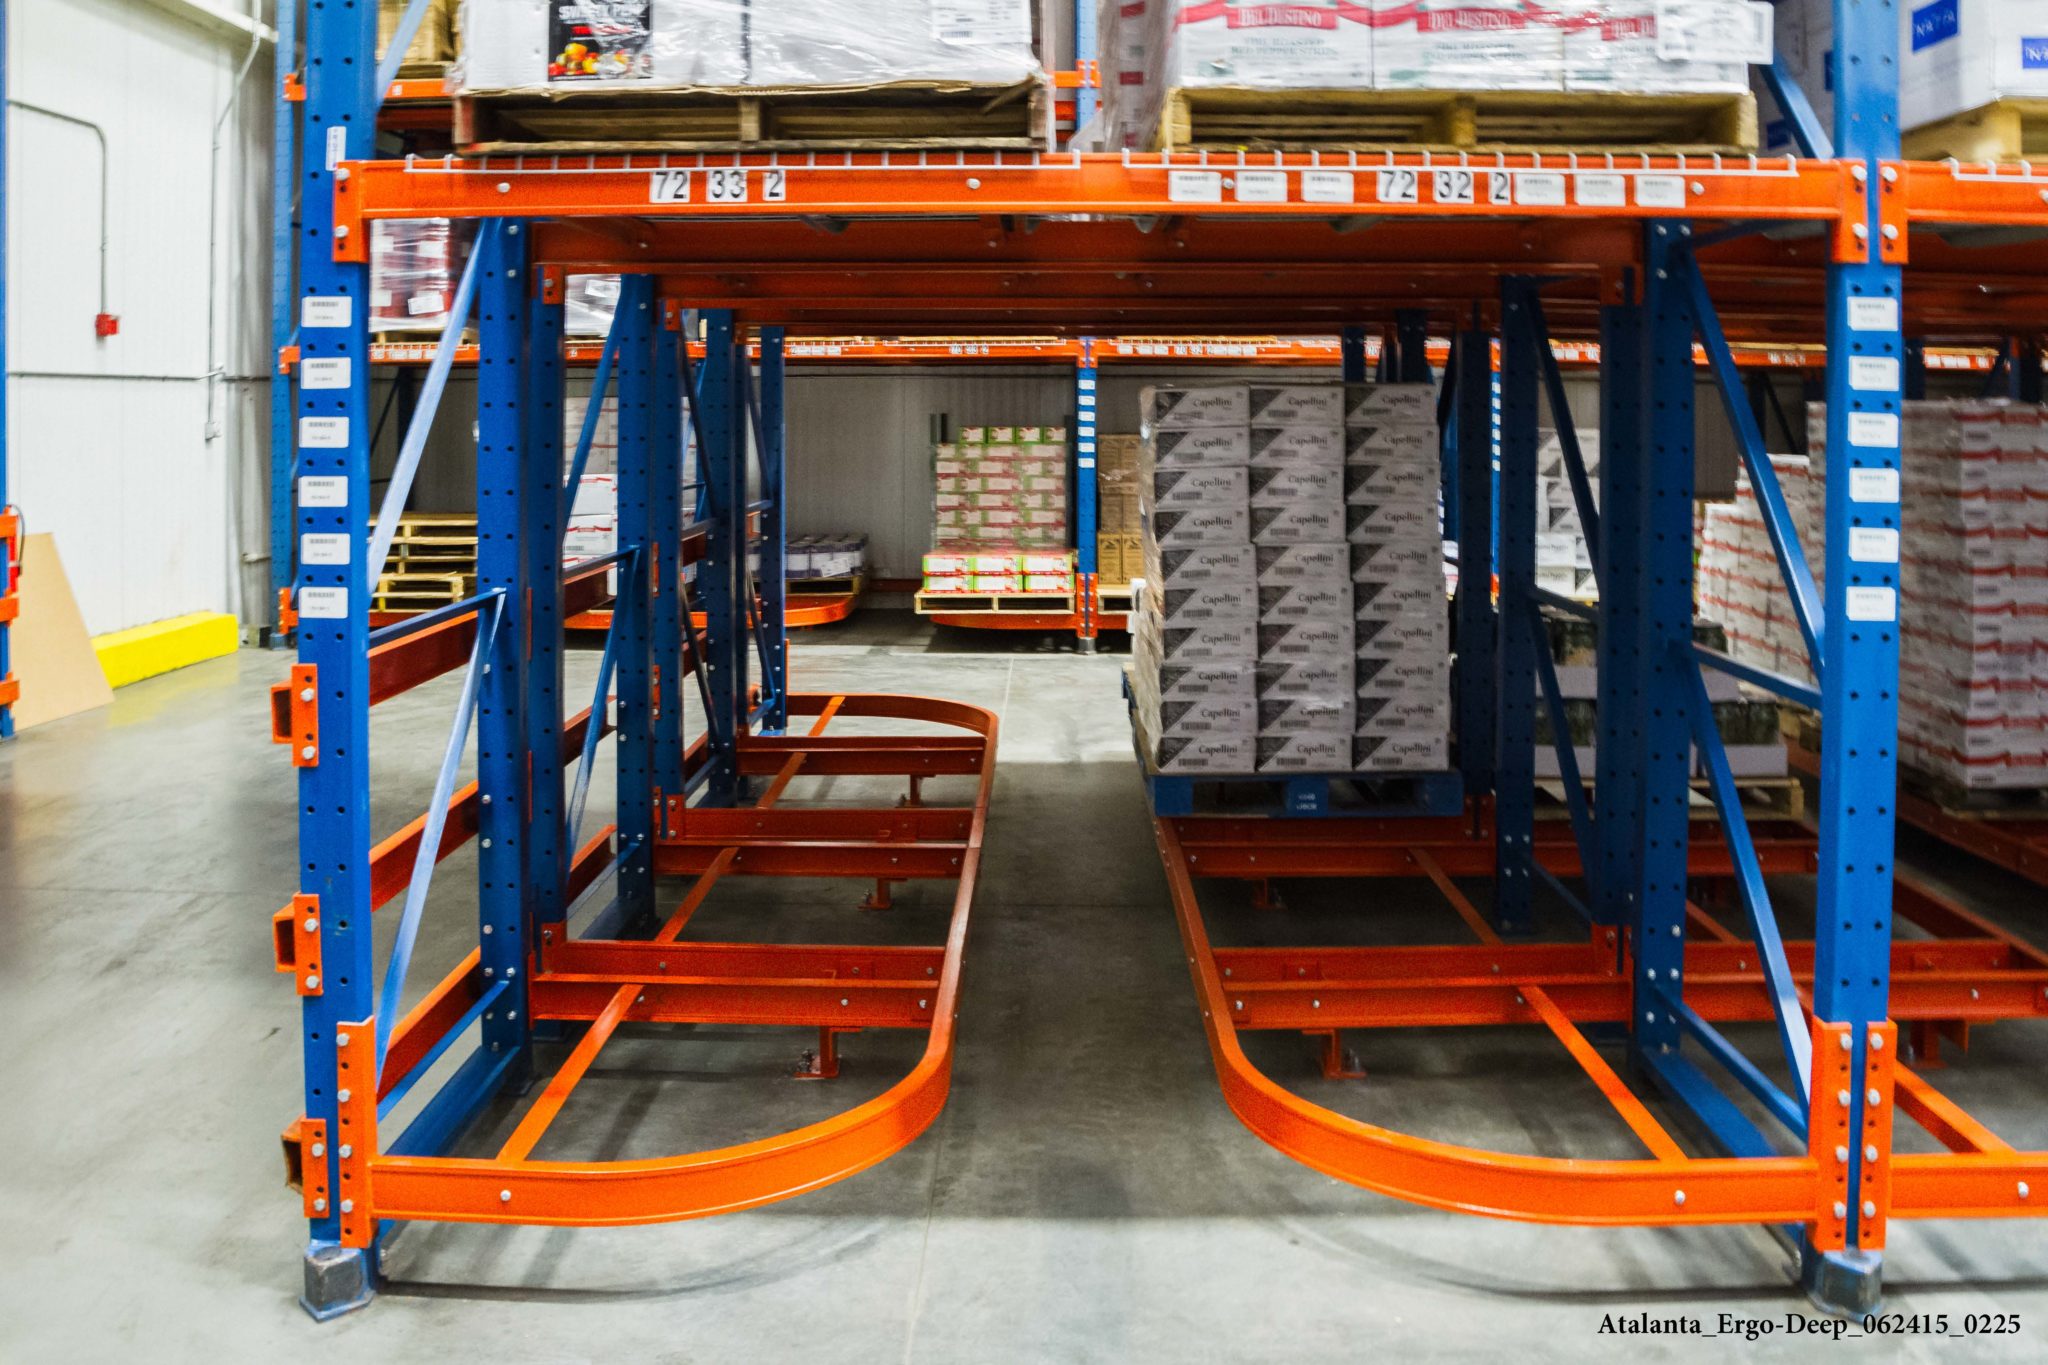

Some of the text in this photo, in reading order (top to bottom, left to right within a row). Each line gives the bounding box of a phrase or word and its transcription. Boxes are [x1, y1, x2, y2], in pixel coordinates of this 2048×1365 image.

[655, 170, 783, 199] 72 33 2
[1382, 170, 1416, 199] 72
[1438, 171, 1472, 200] 32
[1494, 172, 1509, 201] 2
[1193, 396, 1233, 409] Capellini
[1288, 395, 1328, 408] Capellini
[1382, 393, 1422, 406] Capellini
[1194, 436, 1234, 449] Capellini
[1289, 434, 1329, 447] Capellini
[1384, 433, 1424, 446] Capellini
[1192, 476, 1232, 489] Capellini
[1288, 473, 1328, 486] Capellini
[1386, 471, 1426, 484] Capellini
[1193, 515, 1233, 528] Capellini
[1290, 513, 1330, 526] Capellini
[1385, 510, 1425, 523] Capellini
[1200, 553, 1240, 566] Capellini
[1295, 552, 1335, 565] Capellini
[1389, 549, 1429, 562] Capellini
[1202, 592, 1242, 605] Capellini
[1298, 591, 1338, 604] Capellini
[1393, 588, 1433, 601] Capellini
[1202, 632, 1242, 645] Capellini
[1300, 629, 1340, 642] Capellini
[1394, 626, 1434, 639] Capellini
[1199, 670, 1239, 683] Capellini
[1299, 668, 1339, 681] Capellini
[1395, 664, 1435, 677] Capellini
[1202, 707, 1242, 720] Capellini
[1396, 703, 1436, 716] Capellini
[1199, 743, 1239, 756] Capellini
[1297, 742, 1337, 755] Capellini
[1393, 742, 1433, 755] Capellini
